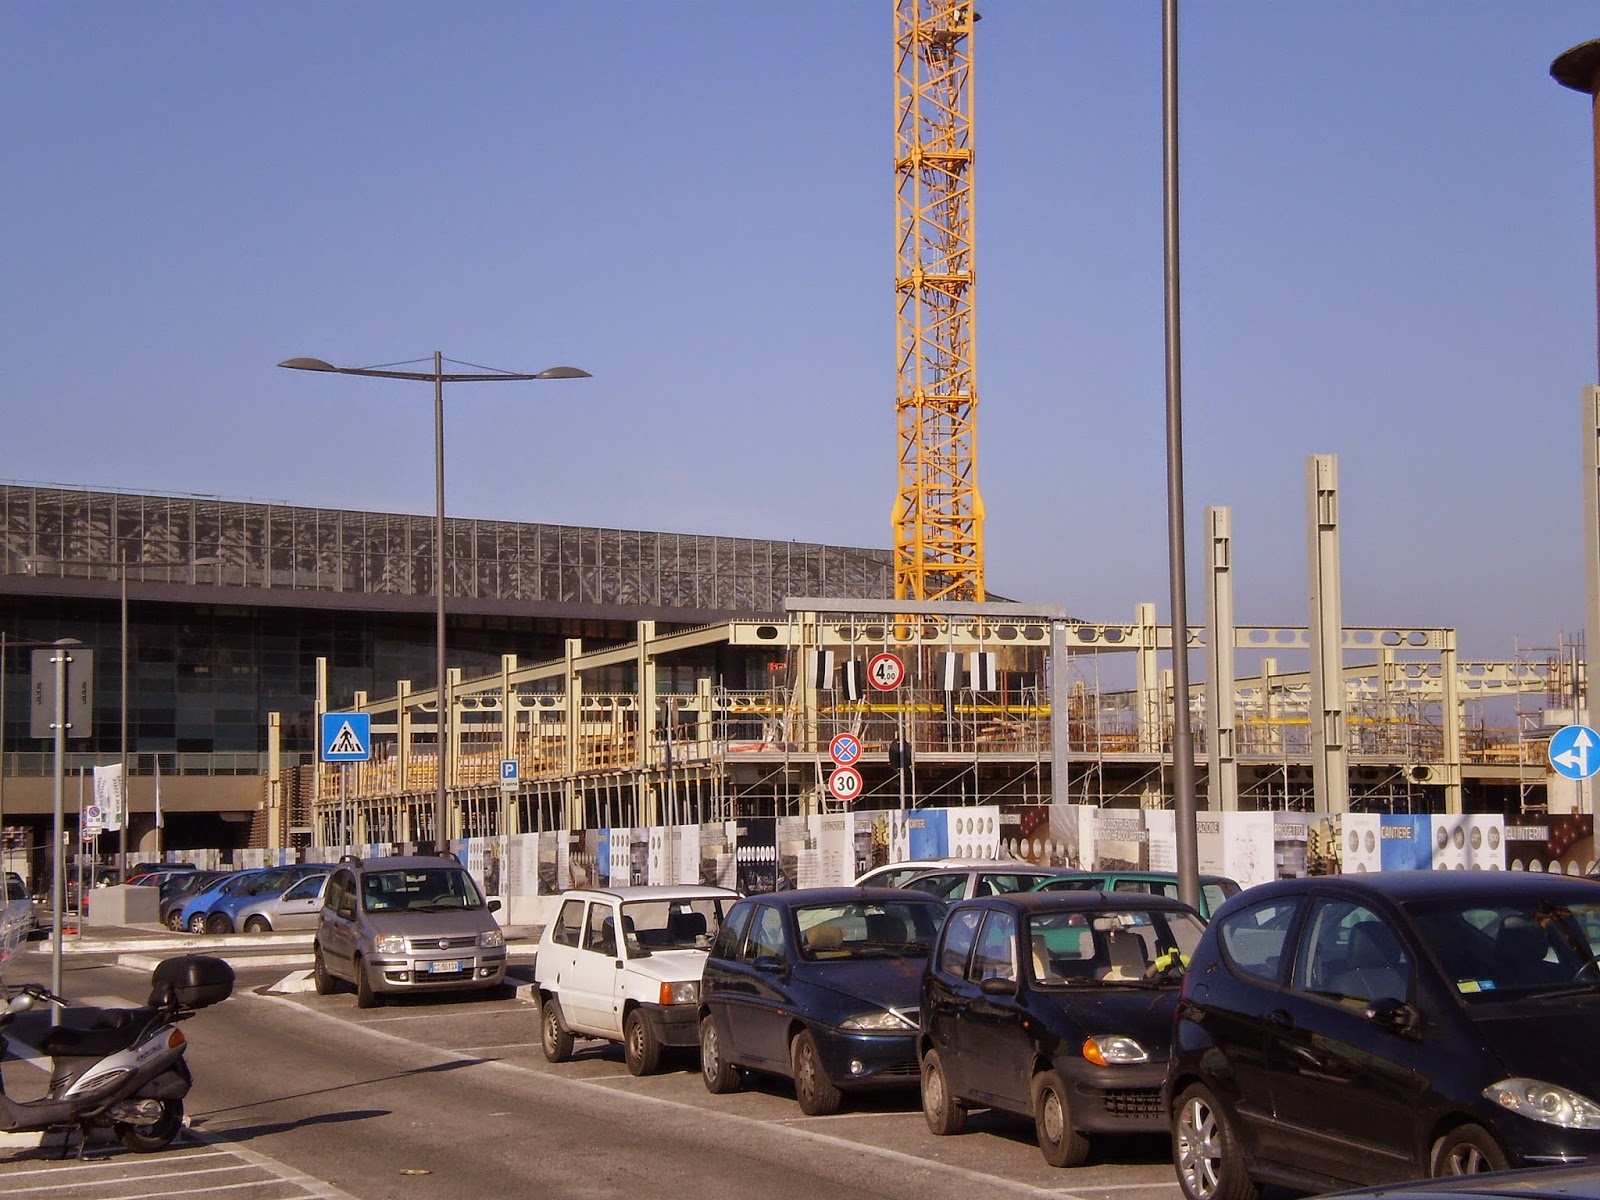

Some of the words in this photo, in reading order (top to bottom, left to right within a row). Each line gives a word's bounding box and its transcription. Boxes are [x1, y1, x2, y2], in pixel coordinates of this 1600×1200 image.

[505, 764, 514, 776] P
[837, 776, 855, 791] 30
[1274, 823, 1304, 836] PROGETTO
[1381, 826, 1411, 839] CANTIERE
[1517, 826, 1547, 840] INTERNI
